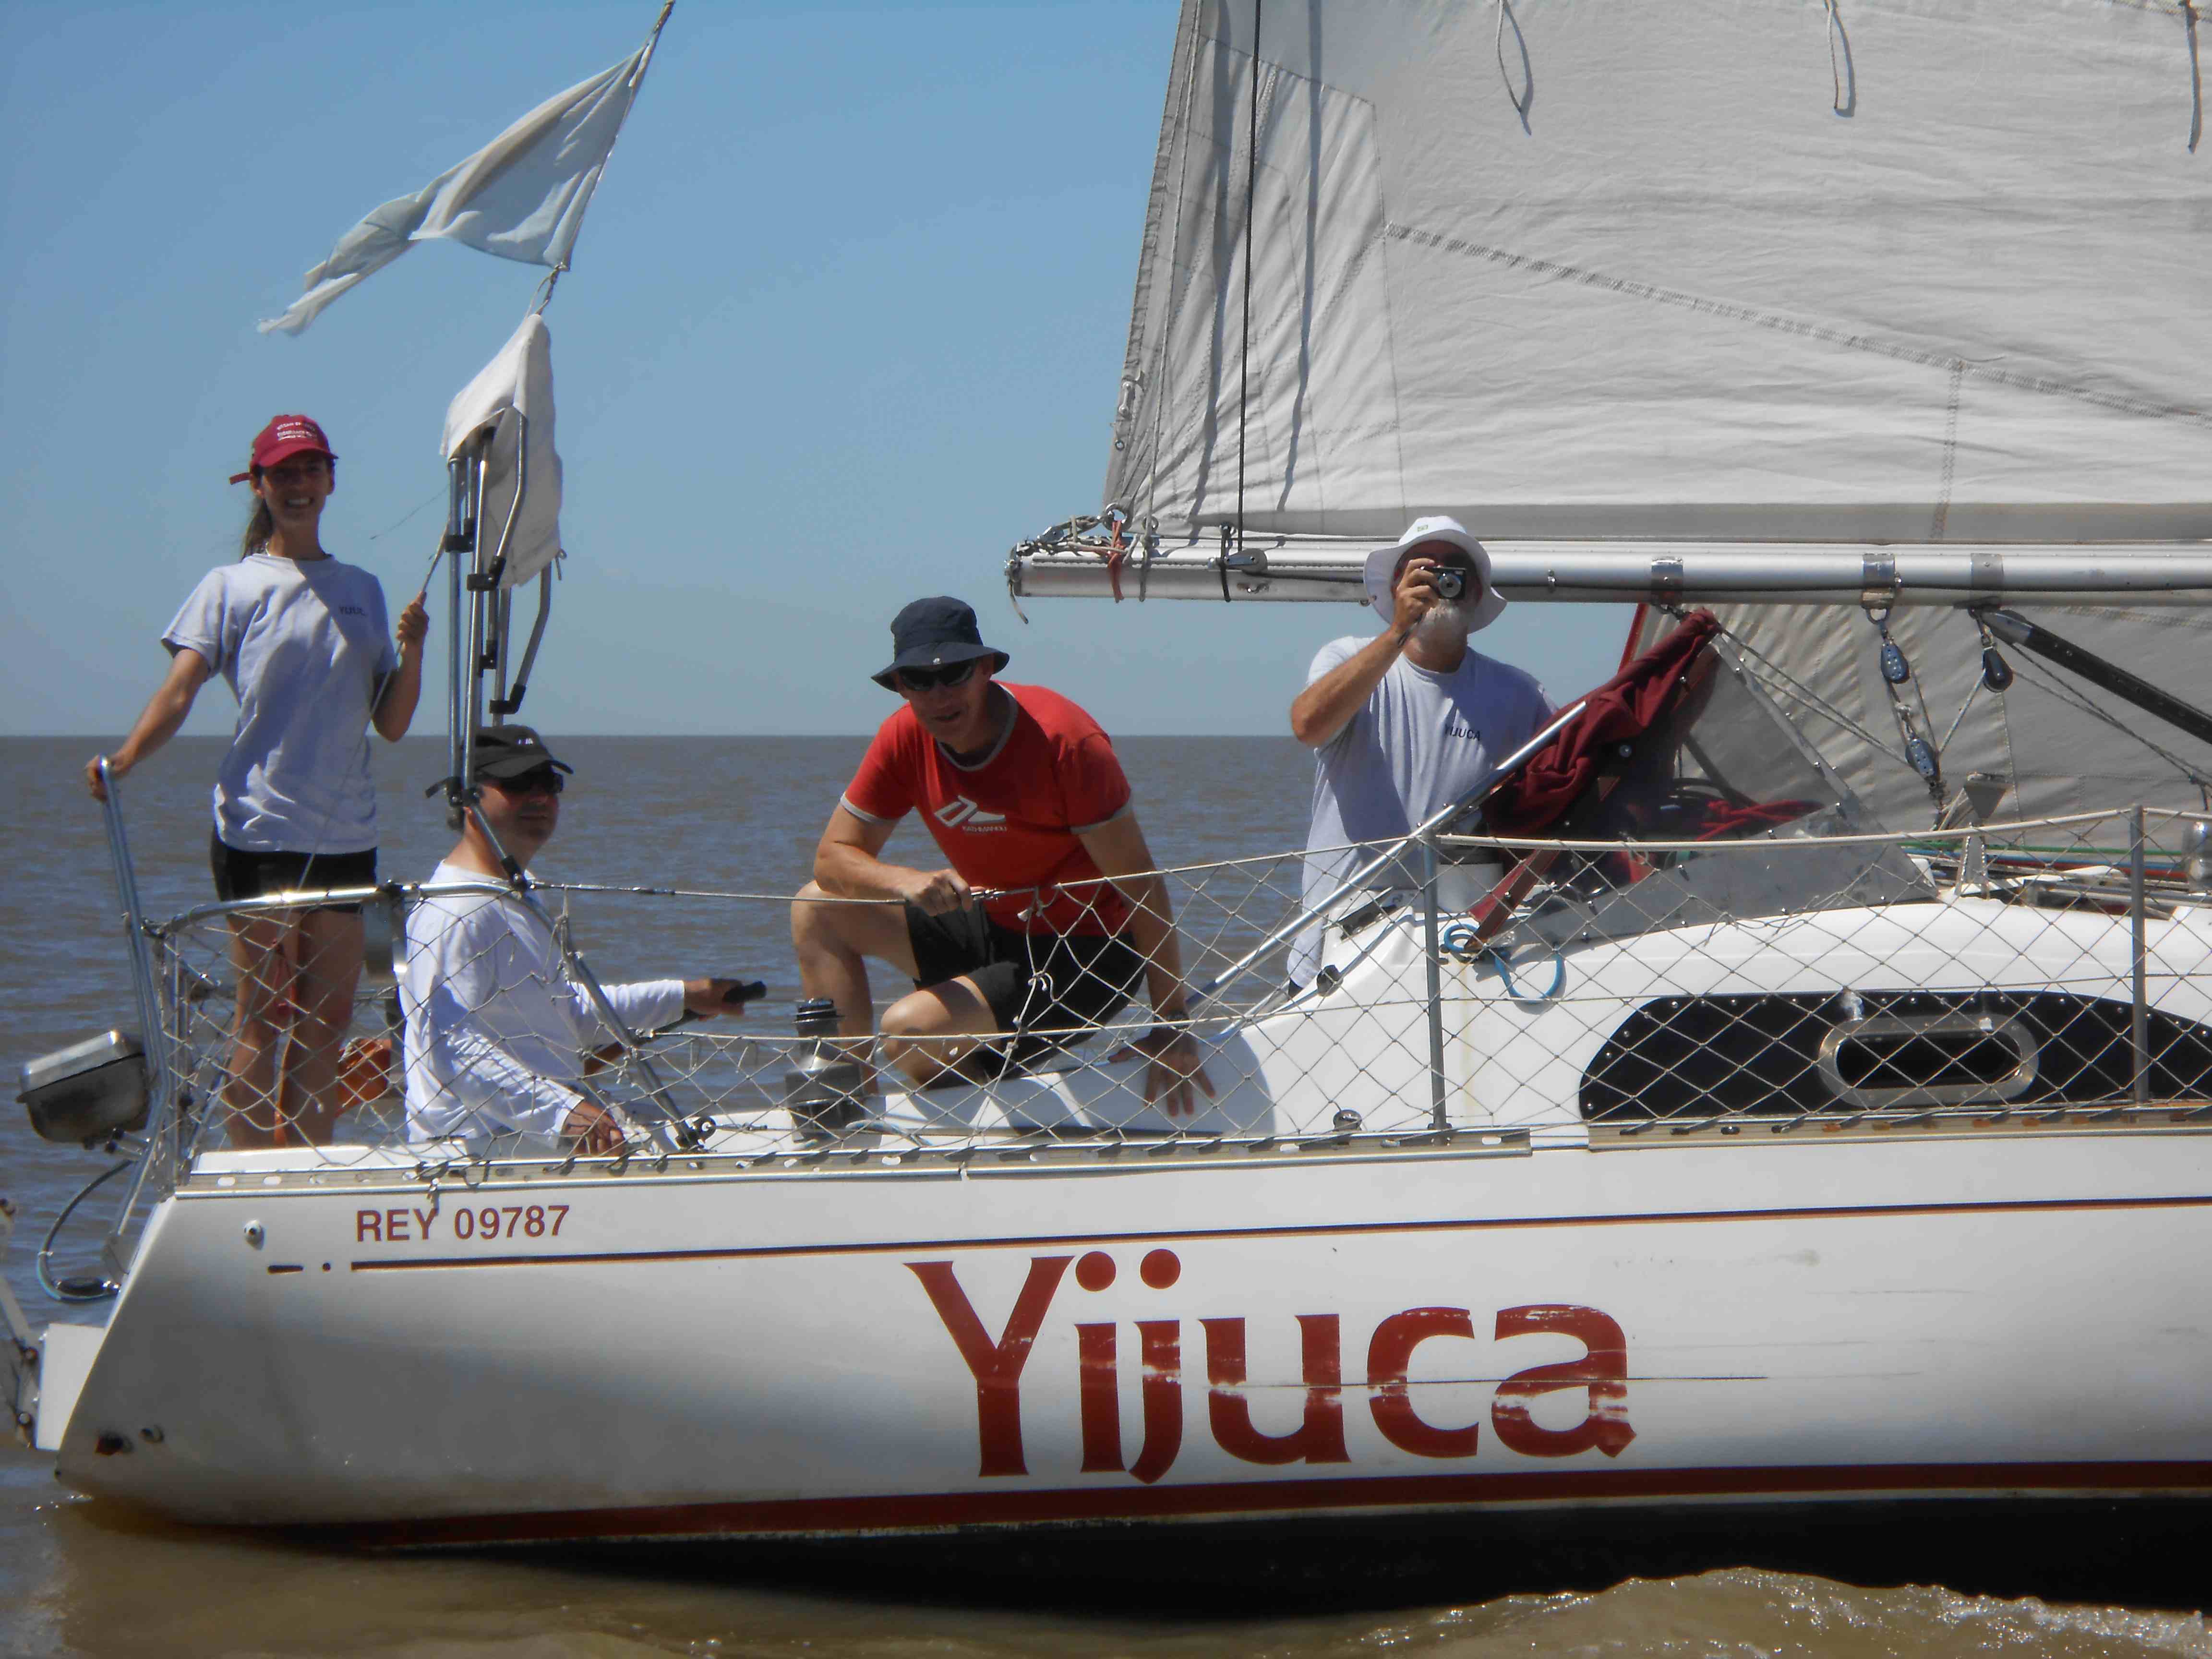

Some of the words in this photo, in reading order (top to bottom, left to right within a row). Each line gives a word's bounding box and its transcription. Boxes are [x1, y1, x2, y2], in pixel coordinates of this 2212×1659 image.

[1444, 724, 1480, 742] YIJUCA
[356, 1208, 437, 1242] REY
[453, 1204, 570, 1240] 09787
[903, 1249, 1636, 1484] Yijuca
